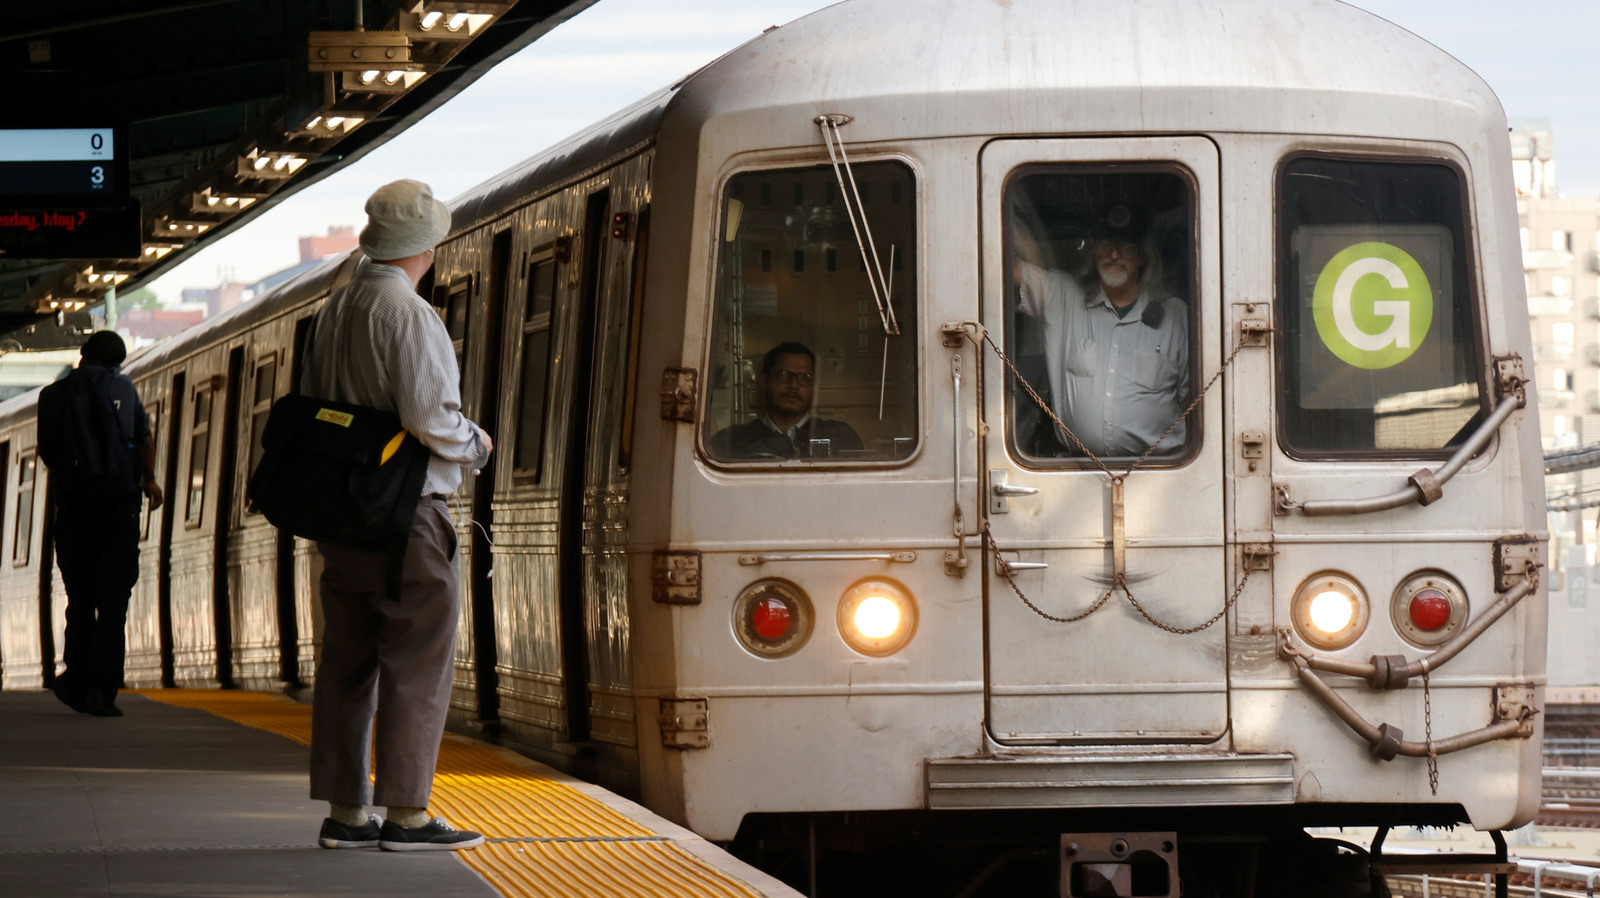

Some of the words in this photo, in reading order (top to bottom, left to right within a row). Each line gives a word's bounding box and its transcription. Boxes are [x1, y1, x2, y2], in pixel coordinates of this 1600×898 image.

[91, 133, 104, 150] 0
[91, 166, 105, 184] 3
[43, 211, 75, 231] May
[1332, 257, 1411, 351] G
